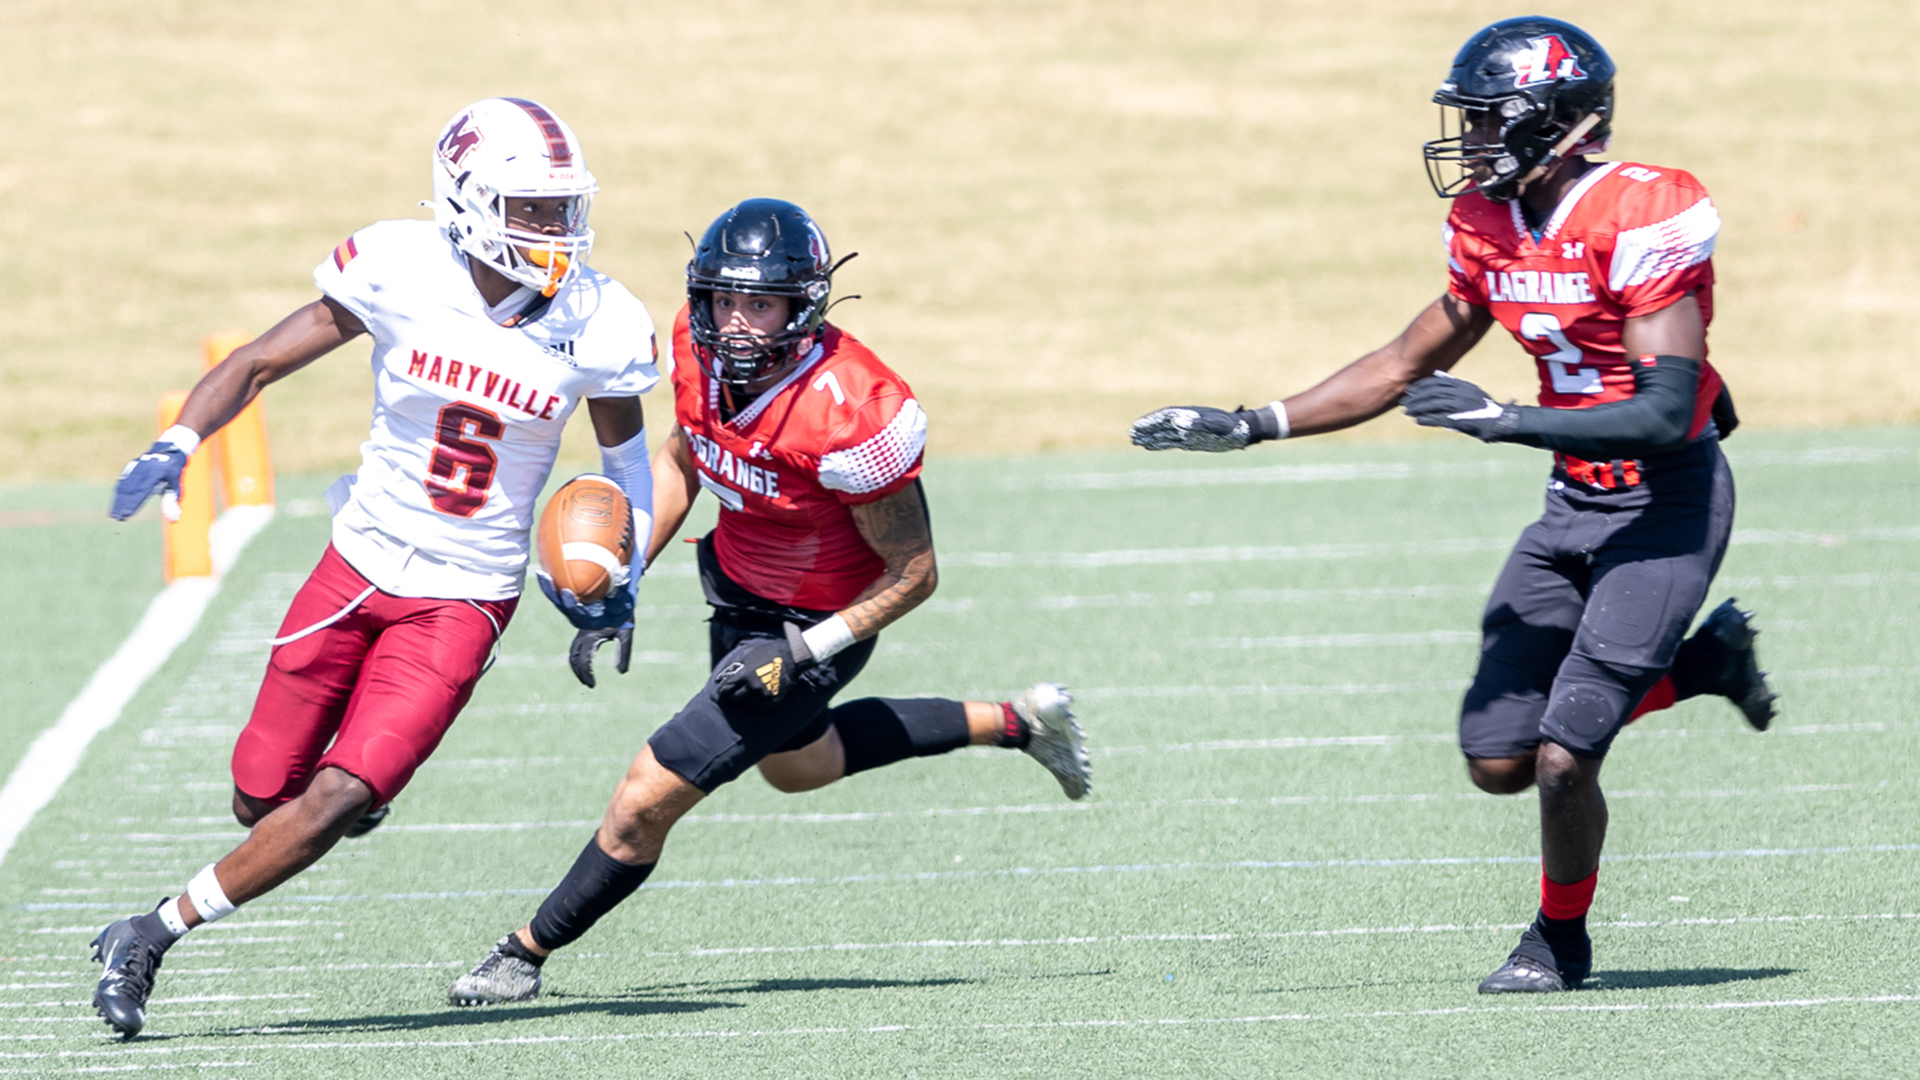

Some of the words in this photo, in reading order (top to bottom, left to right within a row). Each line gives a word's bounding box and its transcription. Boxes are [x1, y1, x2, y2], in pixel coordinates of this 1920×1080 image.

[1618, 166, 1662, 183] 2
[1485, 270, 1598, 305] LAGRANGE
[1520, 311, 1605, 394] 2
[407, 349, 561, 422] MARYVILLE
[812, 370, 846, 406] 7
[424, 400, 507, 518] 6
